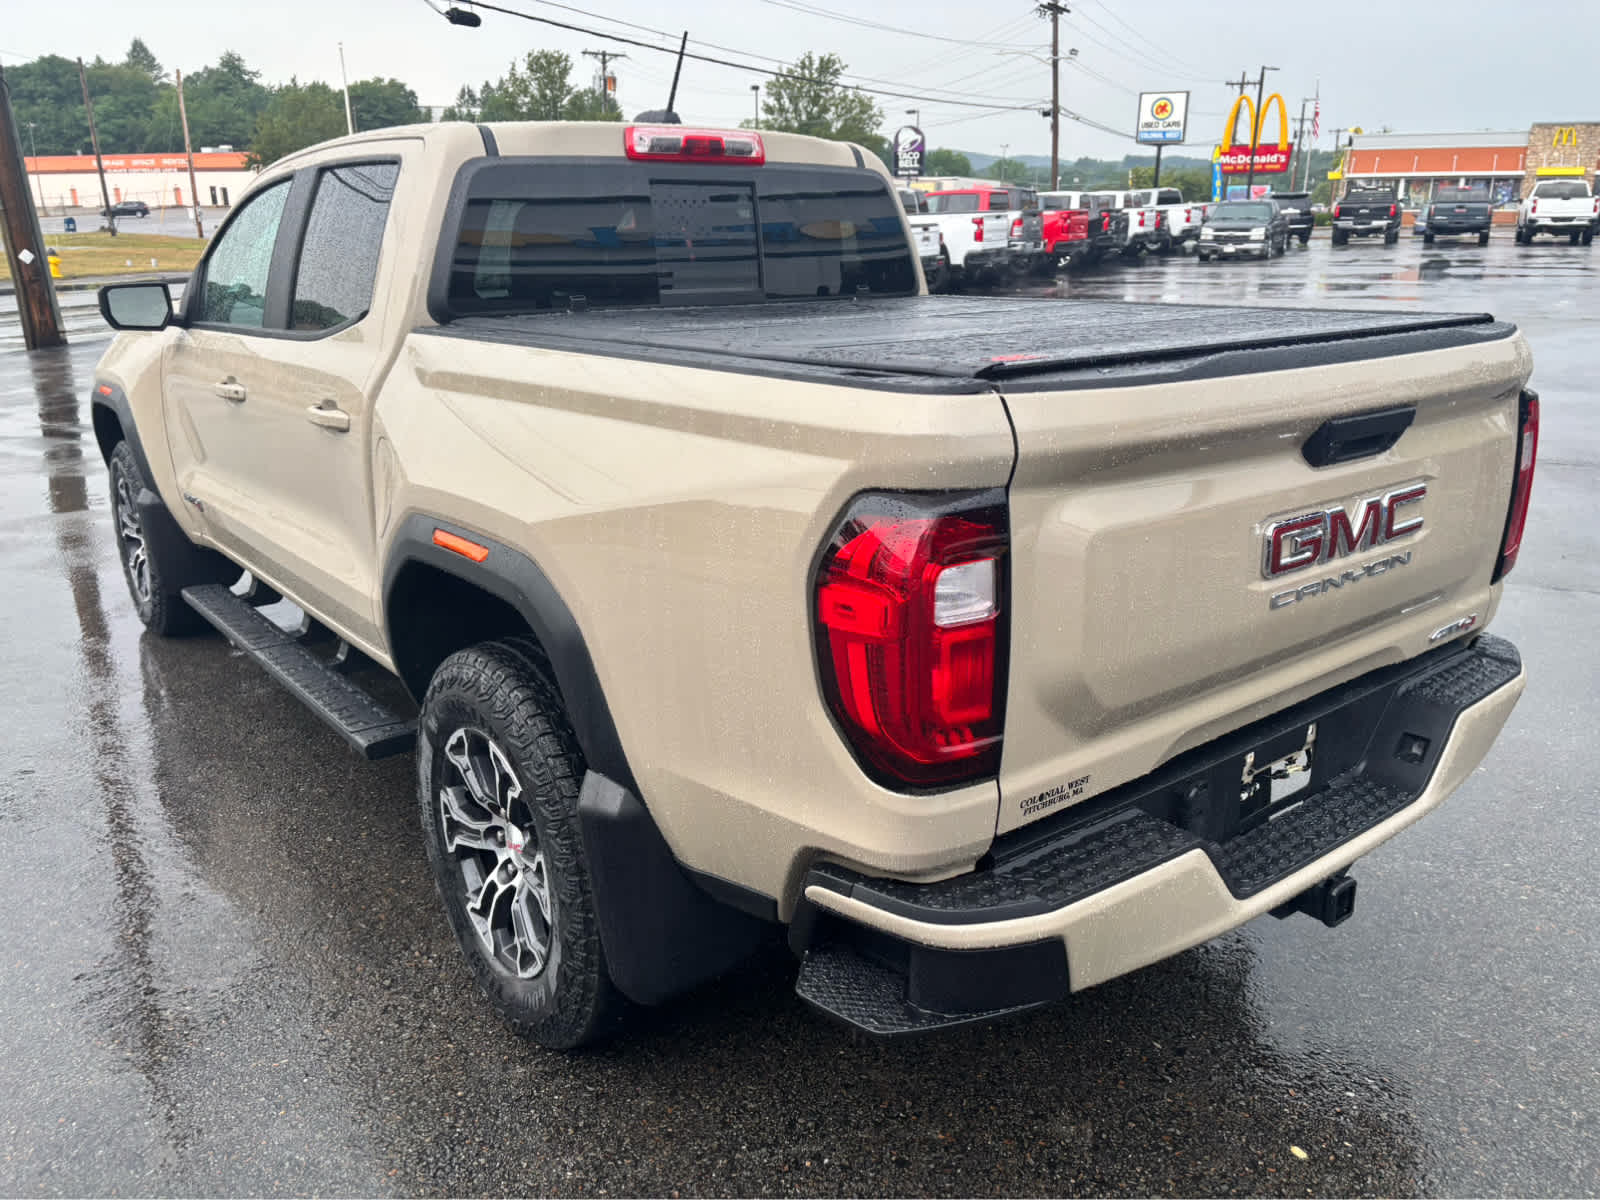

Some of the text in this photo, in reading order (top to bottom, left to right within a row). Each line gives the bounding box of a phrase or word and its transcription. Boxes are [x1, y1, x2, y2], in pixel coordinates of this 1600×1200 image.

[1141, 120, 1181, 129] USED CARS
[897, 151, 920, 160] TACO
[1219, 153, 1287, 165] McDonald's
[898, 159, 920, 168] BELL
[1263, 482, 1428, 580] GMC
[1270, 551, 1412, 610] CANYON
[1020, 775, 1089, 808] COLONIAL WEST
[1072, 787, 1083, 796] MA
